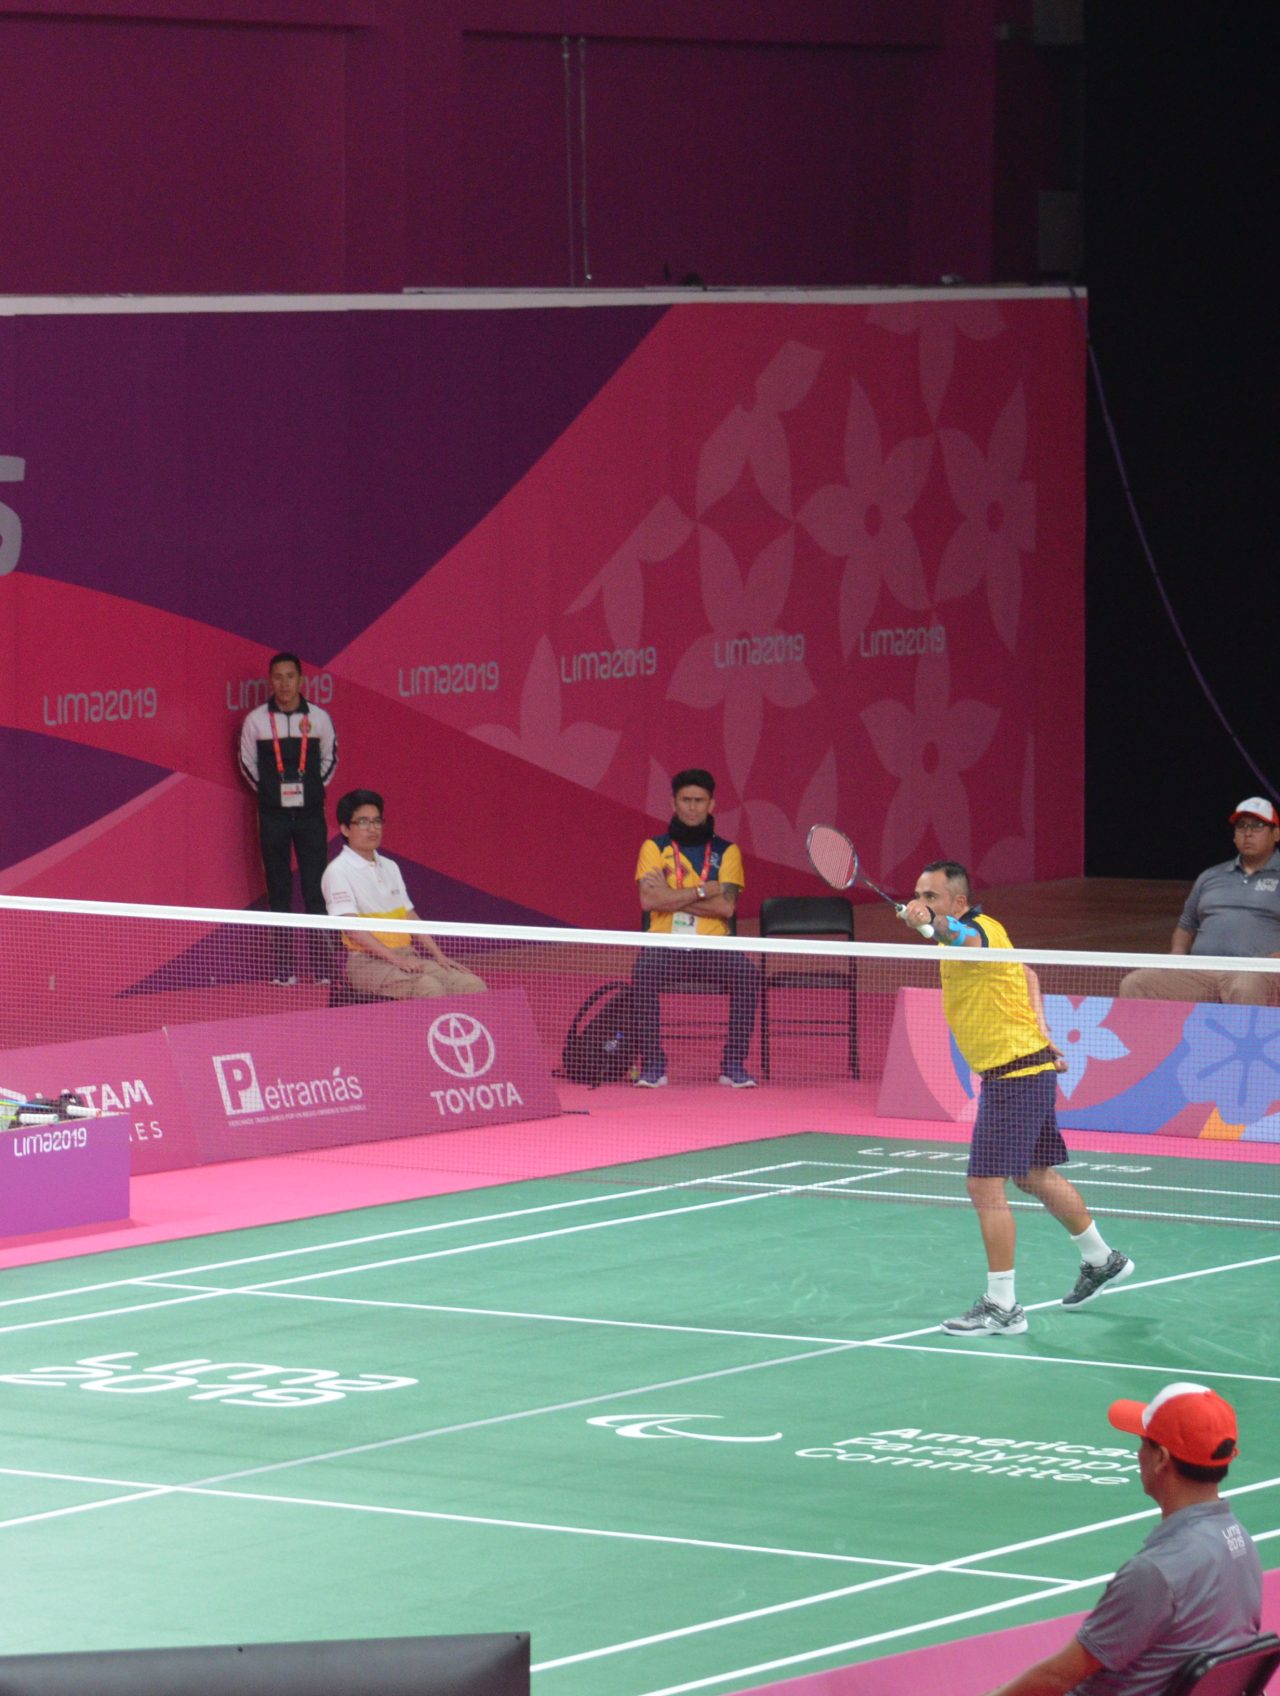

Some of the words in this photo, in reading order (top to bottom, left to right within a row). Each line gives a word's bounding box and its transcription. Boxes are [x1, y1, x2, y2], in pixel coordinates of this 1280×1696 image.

[212, 1052, 364, 1116] Petramás
[431, 1081, 525, 1116] TOYOTA
[832, 1436, 1141, 1474] Paralympi
[869, 1427, 1140, 1460] America
[794, 1447, 1131, 1486] Committee
